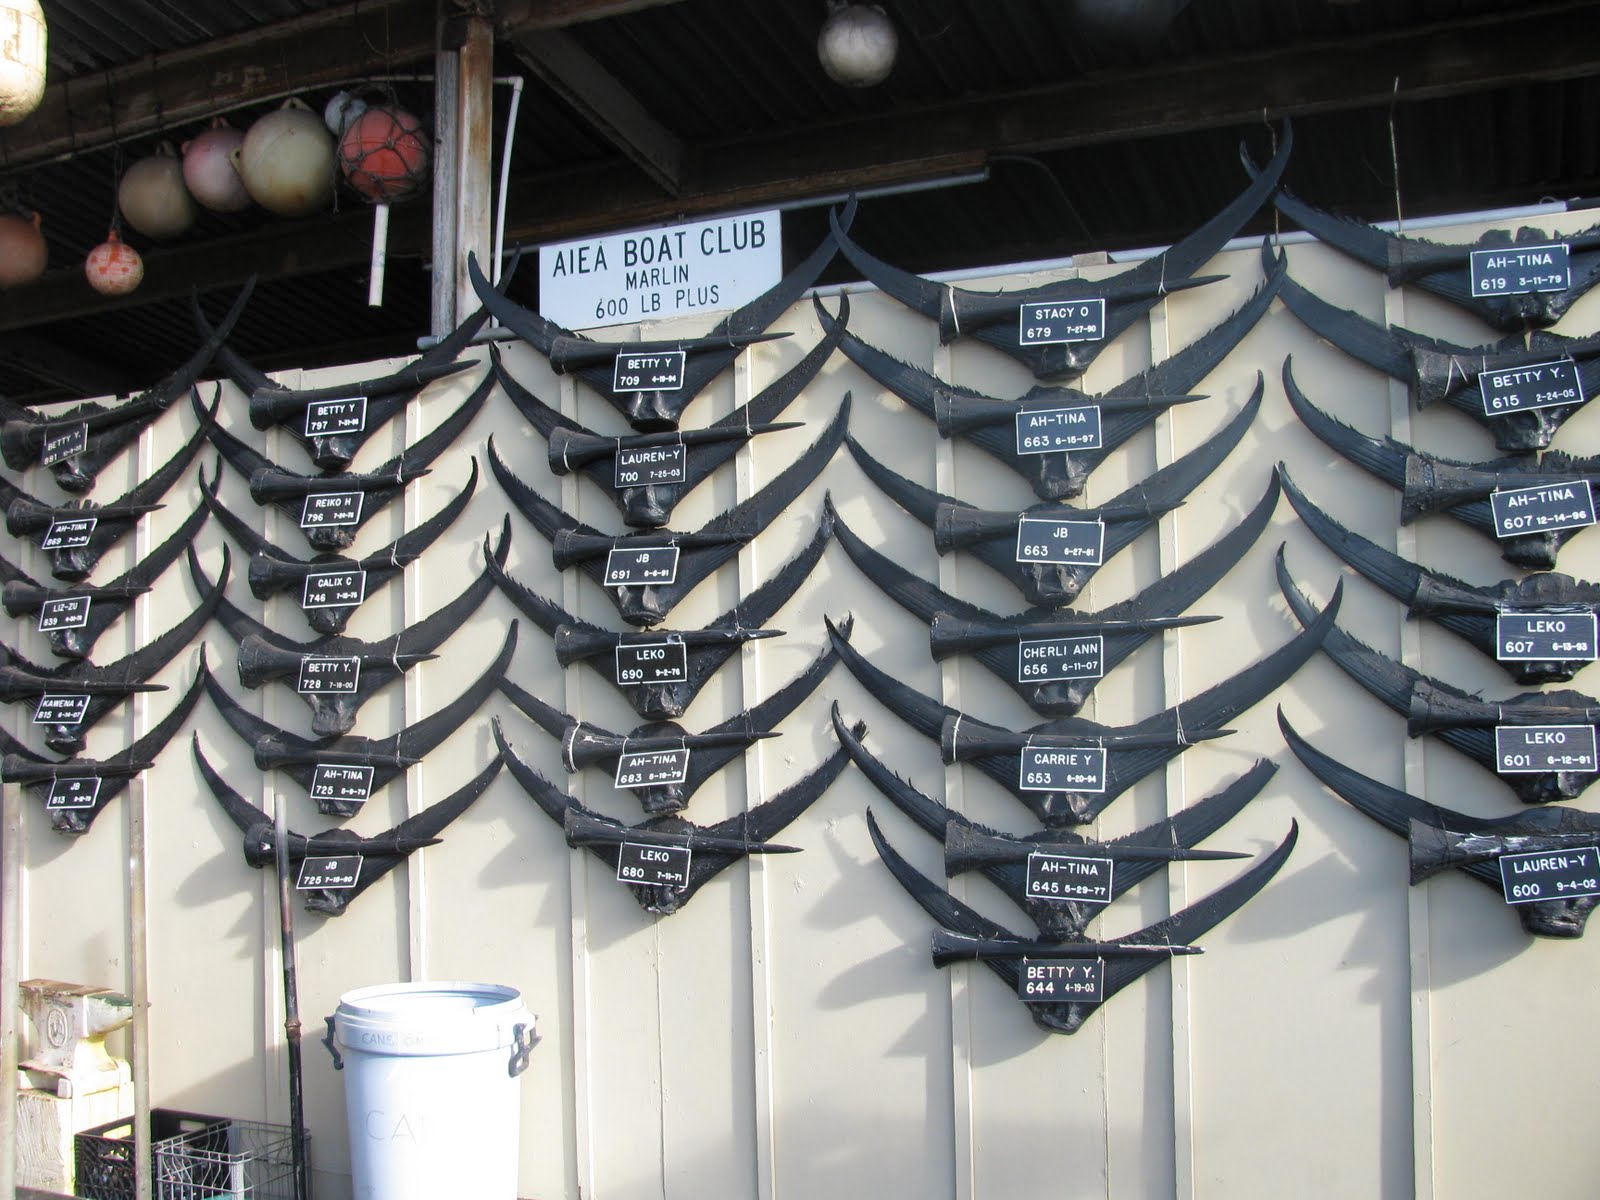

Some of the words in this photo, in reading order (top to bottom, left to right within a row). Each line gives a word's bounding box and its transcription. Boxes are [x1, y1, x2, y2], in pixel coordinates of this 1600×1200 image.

[552, 244, 608, 277] AIEA
[624, 231, 687, 267] BOAT
[700, 219, 766, 256] CLUB
[1487, 253, 1552, 269] AH-TINA
[625, 264, 689, 291] MARLIN
[1480, 278, 1506, 290] 619
[1519, 275, 1562, 286] 3-11-79
[595, 298, 628, 319] 600
[641, 293, 661, 313] LB
[675, 285, 719, 309] PLUS
[1035, 307, 1074, 320] STACY
[1080, 306, 1089, 317] O
[1027, 327, 1051, 339] 679
[627, 359, 660, 369] BETTY
[664, 358, 672, 368] Y
[620, 375, 640, 386] 709
[1492, 370, 1541, 388] BETTY
[1550, 367, 1565, 378] Y.
[1492, 394, 1520, 408] 615
[1536, 388, 1575, 402] 2-24-05
[317, 405, 346, 416] BETTY
[349, 403, 355, 412] Y
[311, 421, 328, 430] 797
[1029, 412, 1087, 428] AH-TINA
[47, 434, 71, 451] BETTY
[1024, 435, 1050, 447] 663
[621, 450, 681, 465] LAUREN-Y
[620, 472, 639, 482] 700
[650, 468, 681, 479] 7-25-03
[315, 498, 342, 508] REIKO
[344, 497, 352, 506] H
[1508, 488, 1574, 507] AH-TINA
[307, 513, 324, 522] 796
[1503, 515, 1533, 529] 607
[1536, 510, 1587, 525] 12-14-96
[56, 523, 87, 533] AH-TINA
[1053, 527, 1068, 539] JB
[47, 538, 62, 546] 869
[1024, 545, 1049, 557] 663
[635, 553, 650, 563] JB
[611, 570, 631, 580] 691
[318, 577, 343, 588] CALIX
[346, 577, 352, 586] C
[309, 593, 326, 603] 746
[53, 602, 79, 613] LIZ-ZU
[44, 617, 58, 626] 839
[1527, 620, 1566, 633] LEKO
[1023, 645, 1067, 659] CHERLI
[1073, 643, 1098, 656] ANN
[1505, 641, 1534, 653] 607
[636, 649, 666, 661] LEKO
[308, 663, 339, 673] BETTY
[343, 663, 351, 672] Y.
[1023, 663, 1048, 675] 656
[1062, 661, 1098, 671] 6-11-07
[621, 669, 643, 680] 690
[303, 679, 322, 689] 728
[43, 700, 75, 708] KAWENA
[38, 711, 52, 719] 815
[1525, 732, 1566, 744] LEKO
[629, 754, 677, 767] AH-TINA
[1034, 753, 1078, 766] CARRIE
[1083, 754, 1092, 765] Y
[1503, 754, 1530, 766] 601
[324, 770, 363, 780] AH-TINA
[620, 773, 642, 784] 683
[1027, 772, 1052, 784] 653
[70, 782, 81, 790] JB
[316, 785, 334, 795] 725
[52, 796, 66, 804] 813
[640, 849, 670, 862] LEKO
[325, 861, 338, 870] JB
[1041, 861, 1098, 876] AH-TINA
[1513, 855, 1586, 874] LAUREN-Y
[622, 866, 645, 878] 680
[303, 875, 322, 885] 725
[1032, 881, 1059, 893] 645
[1512, 883, 1540, 897] 600
[1556, 878, 1597, 891] 9-4-02
[1027, 966, 1075, 979] BETTY
[1082, 966, 1095, 979] Y.
[1026, 981, 1055, 994] 644
[1065, 982, 1095, 992] 4-19-03
